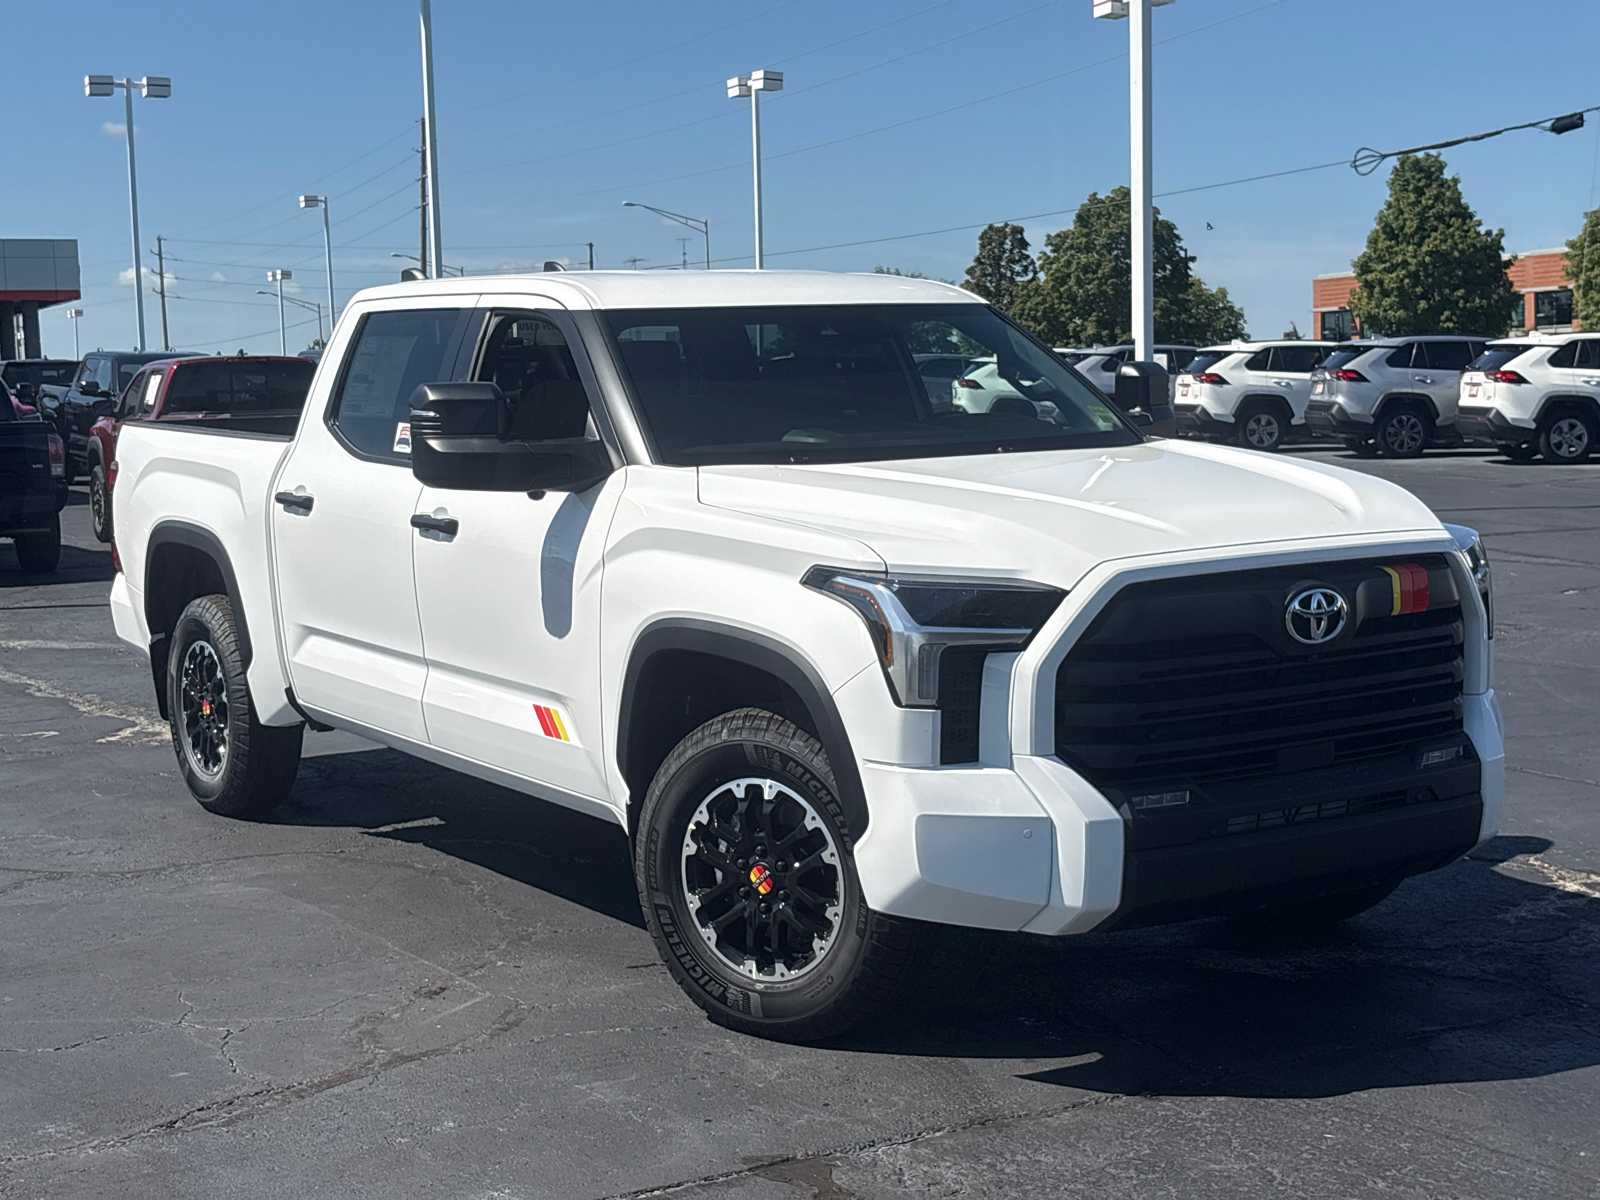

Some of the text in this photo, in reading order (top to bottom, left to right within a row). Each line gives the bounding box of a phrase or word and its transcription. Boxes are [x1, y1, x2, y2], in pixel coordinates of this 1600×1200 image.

[519, 322, 540, 331] USED
[784, 760, 854, 852] MICHELIN
[752, 869, 771, 889] TOYOTA
[657, 908, 725, 998] MICHELIN
